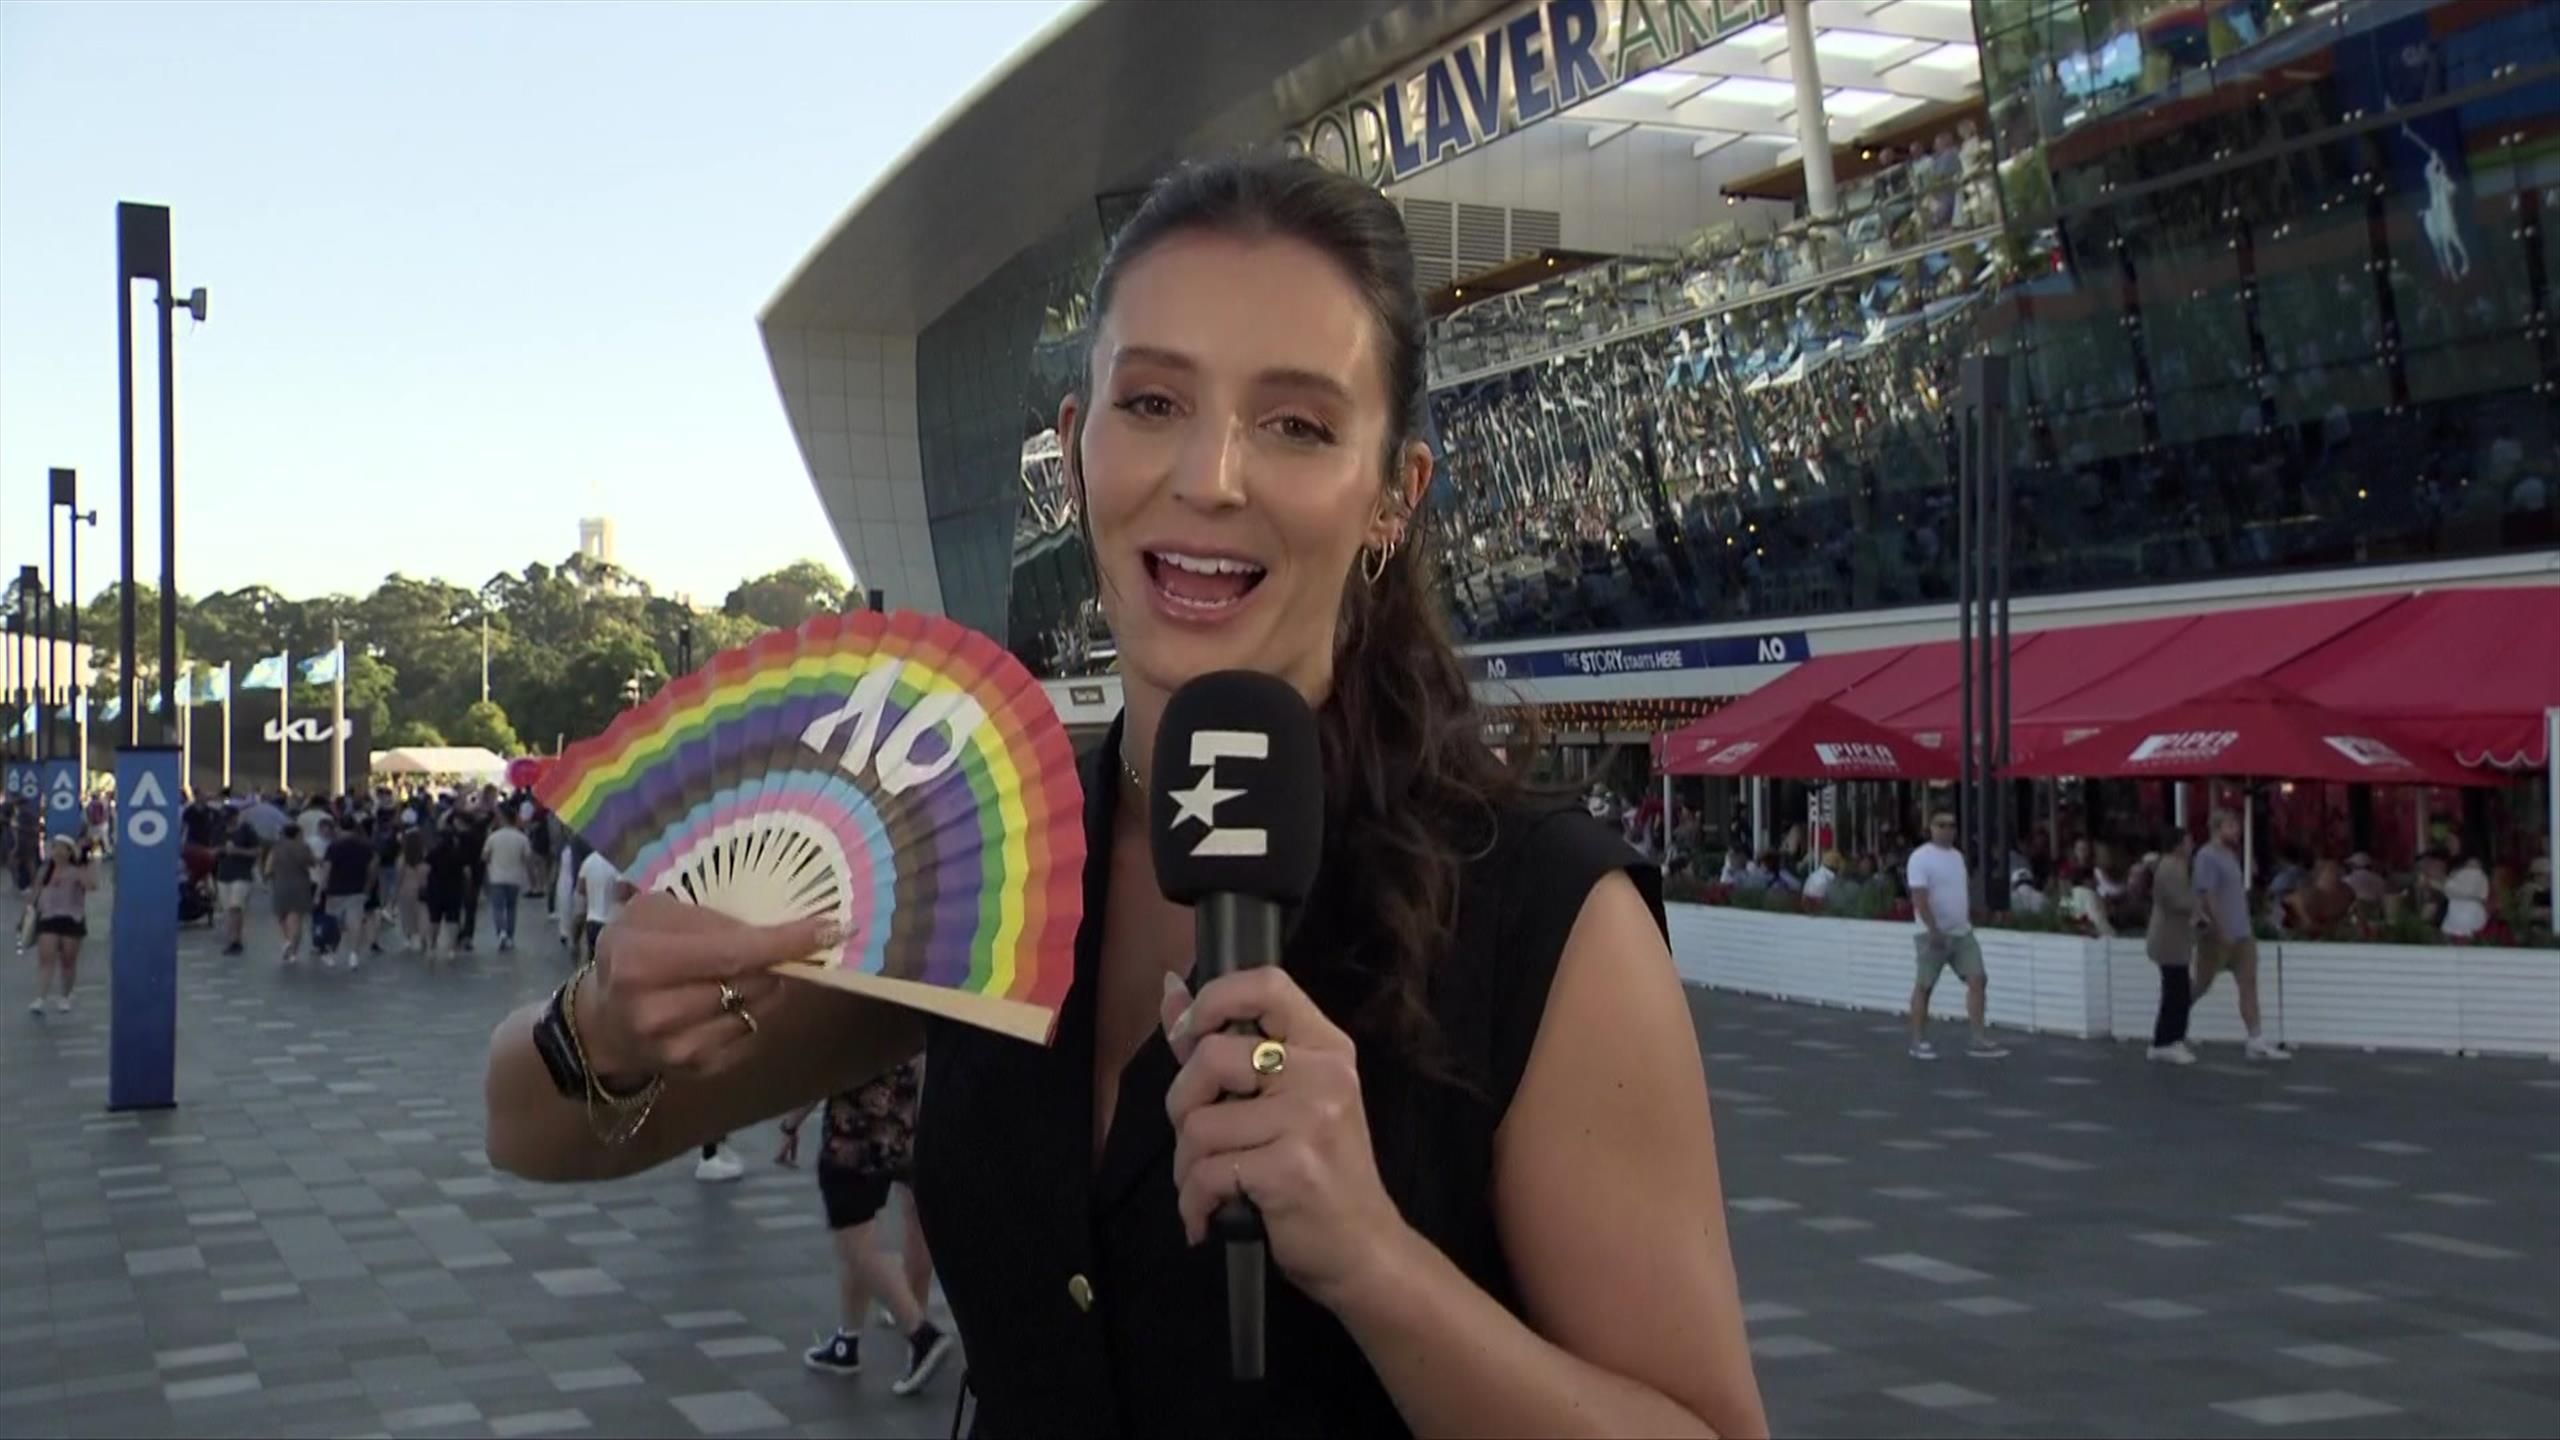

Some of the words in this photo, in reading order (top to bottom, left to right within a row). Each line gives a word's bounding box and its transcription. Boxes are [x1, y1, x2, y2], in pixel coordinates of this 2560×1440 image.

[1382, 0, 1608, 181] LAVER
[1487, 658, 1507, 678] AO
[1580, 649, 1623, 673] STORY
[1622, 654, 1656, 671] STARTS
[1654, 649, 1683, 668] HERE
[1758, 637, 1787, 662] AO
[800, 658, 986, 797] AO
[52, 768, 75, 811] AO
[127, 770, 168, 847] AO
